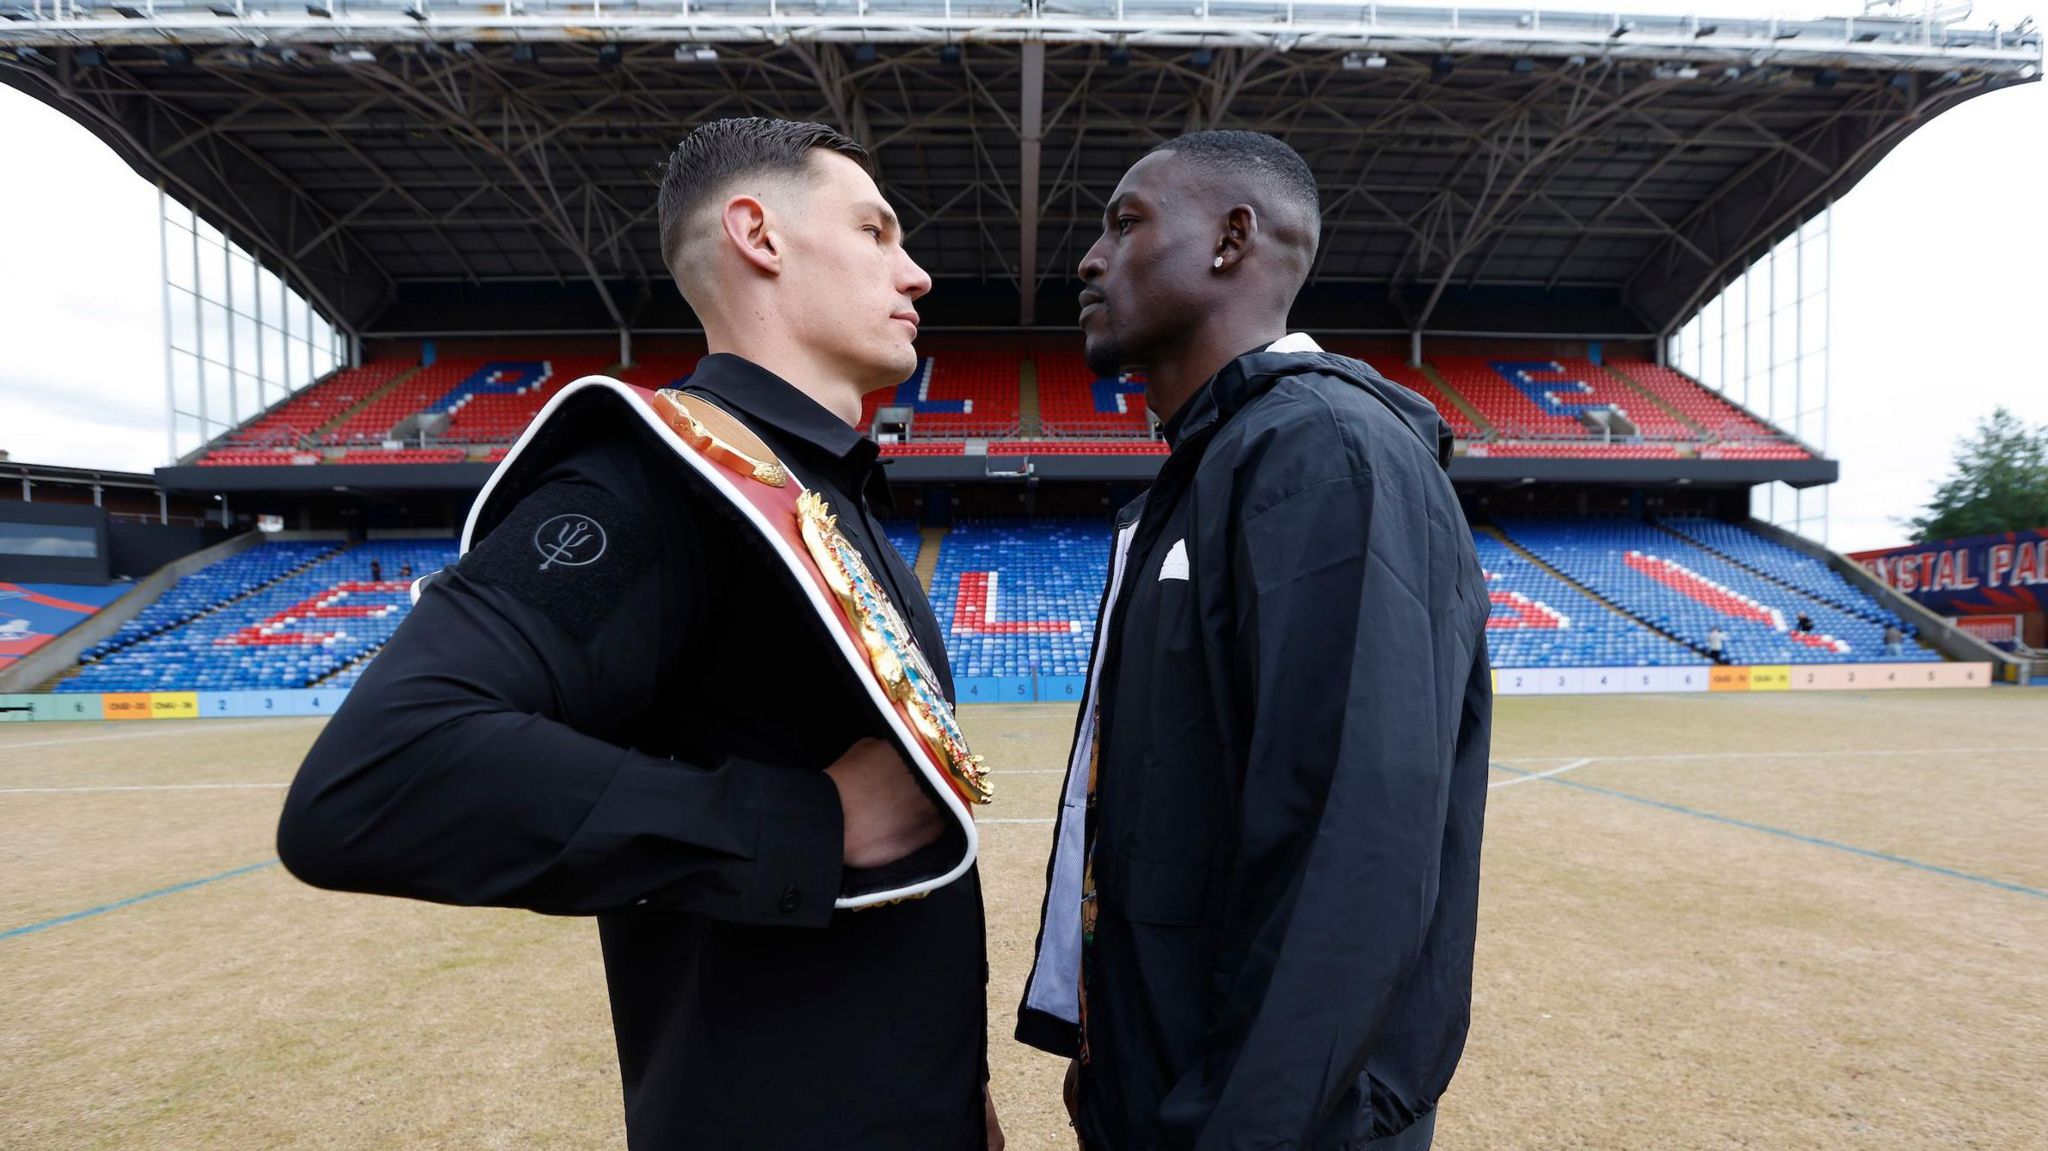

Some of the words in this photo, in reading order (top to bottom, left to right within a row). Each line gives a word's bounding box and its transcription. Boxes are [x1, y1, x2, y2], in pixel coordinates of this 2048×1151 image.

[970, 684, 978, 695] 4
[1017, 684, 1025, 695] 5
[1065, 683, 1073, 694] 6
